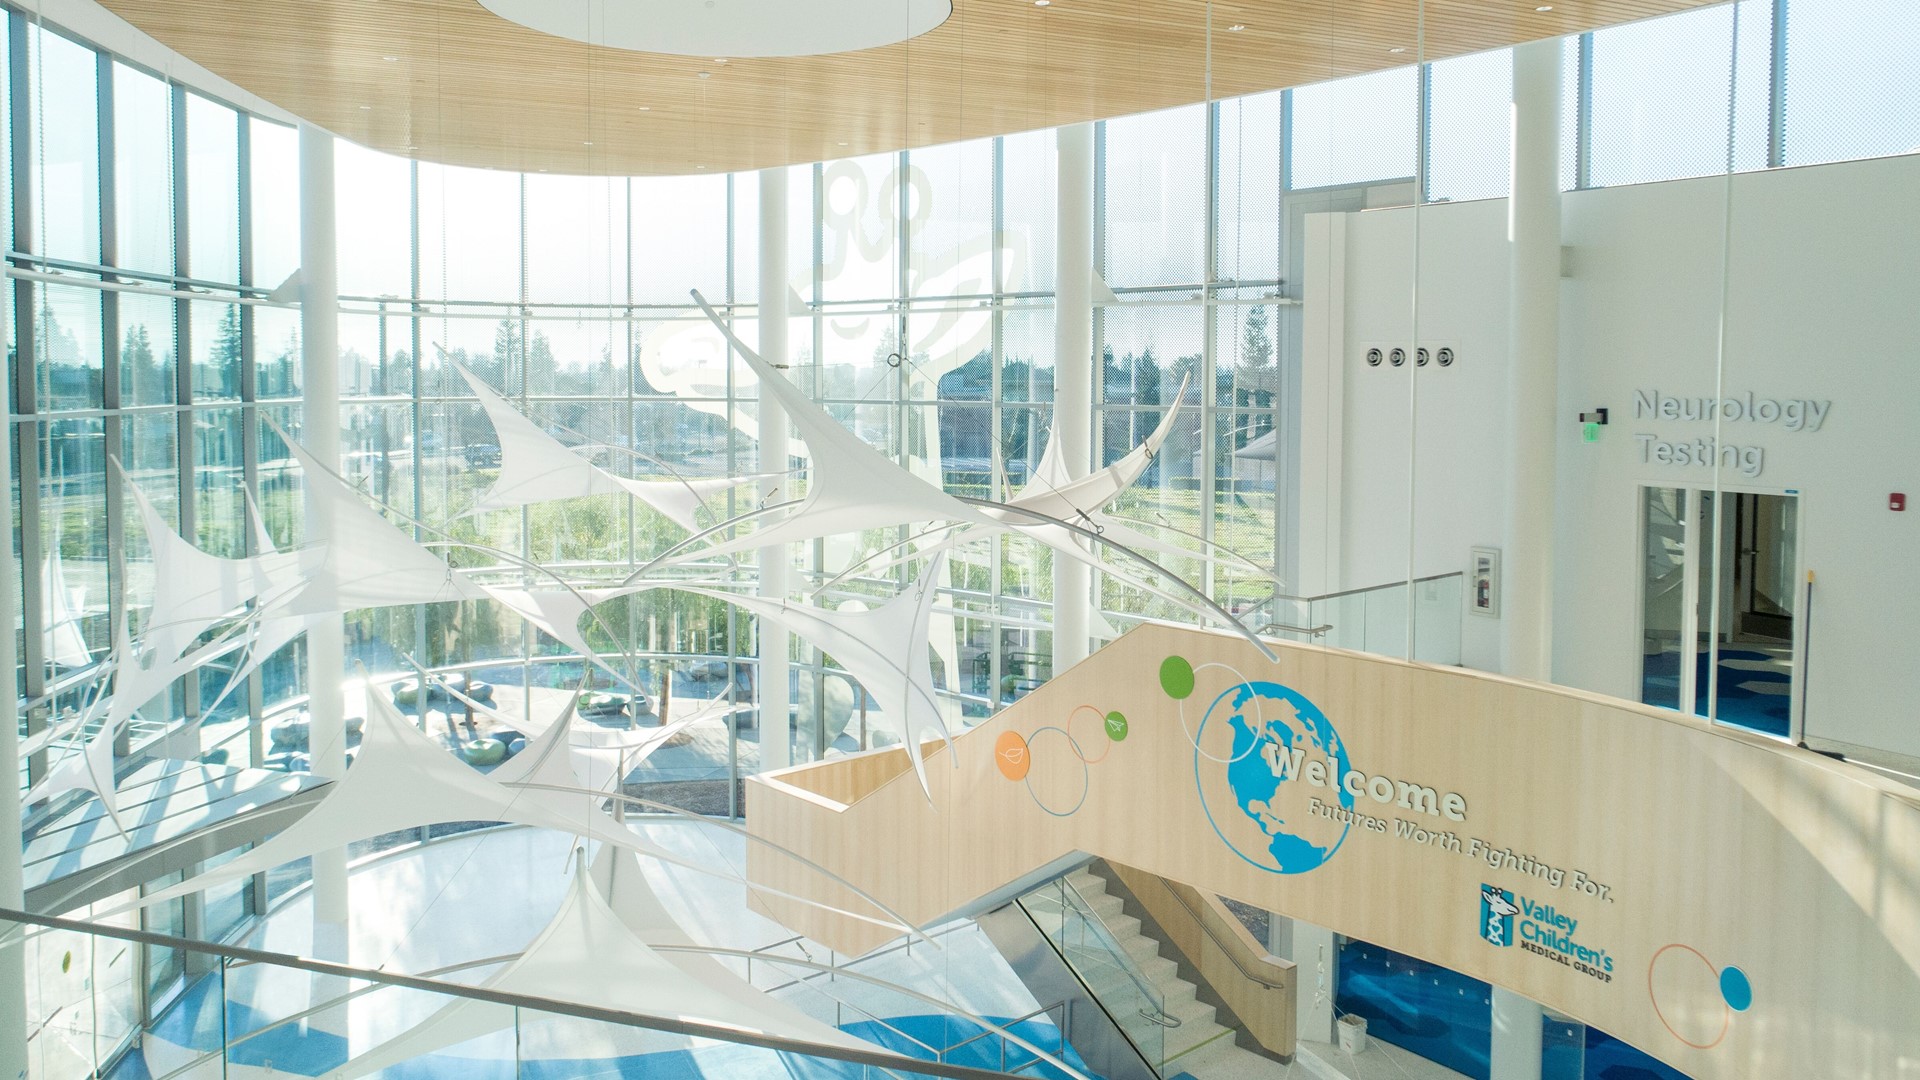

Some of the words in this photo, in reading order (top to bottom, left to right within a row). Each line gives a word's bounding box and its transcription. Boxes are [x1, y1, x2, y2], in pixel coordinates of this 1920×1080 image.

[1634, 390, 1831, 432] Neurology
[1634, 433, 1765, 478] Testing
[1265, 741, 1467, 822] Welcome
[1307, 797, 1387, 834] Futures
[1394, 817, 1462, 854] Worth
[1467, 837, 1566, 890] Fighting
[1570, 870, 1614, 903] For.
[1520, 896, 1577, 937] Valley
[1520, 919, 1614, 972] Children's
[1521, 940, 1571, 967] MEDICAL
[1573, 961, 1612, 984] GROUP
